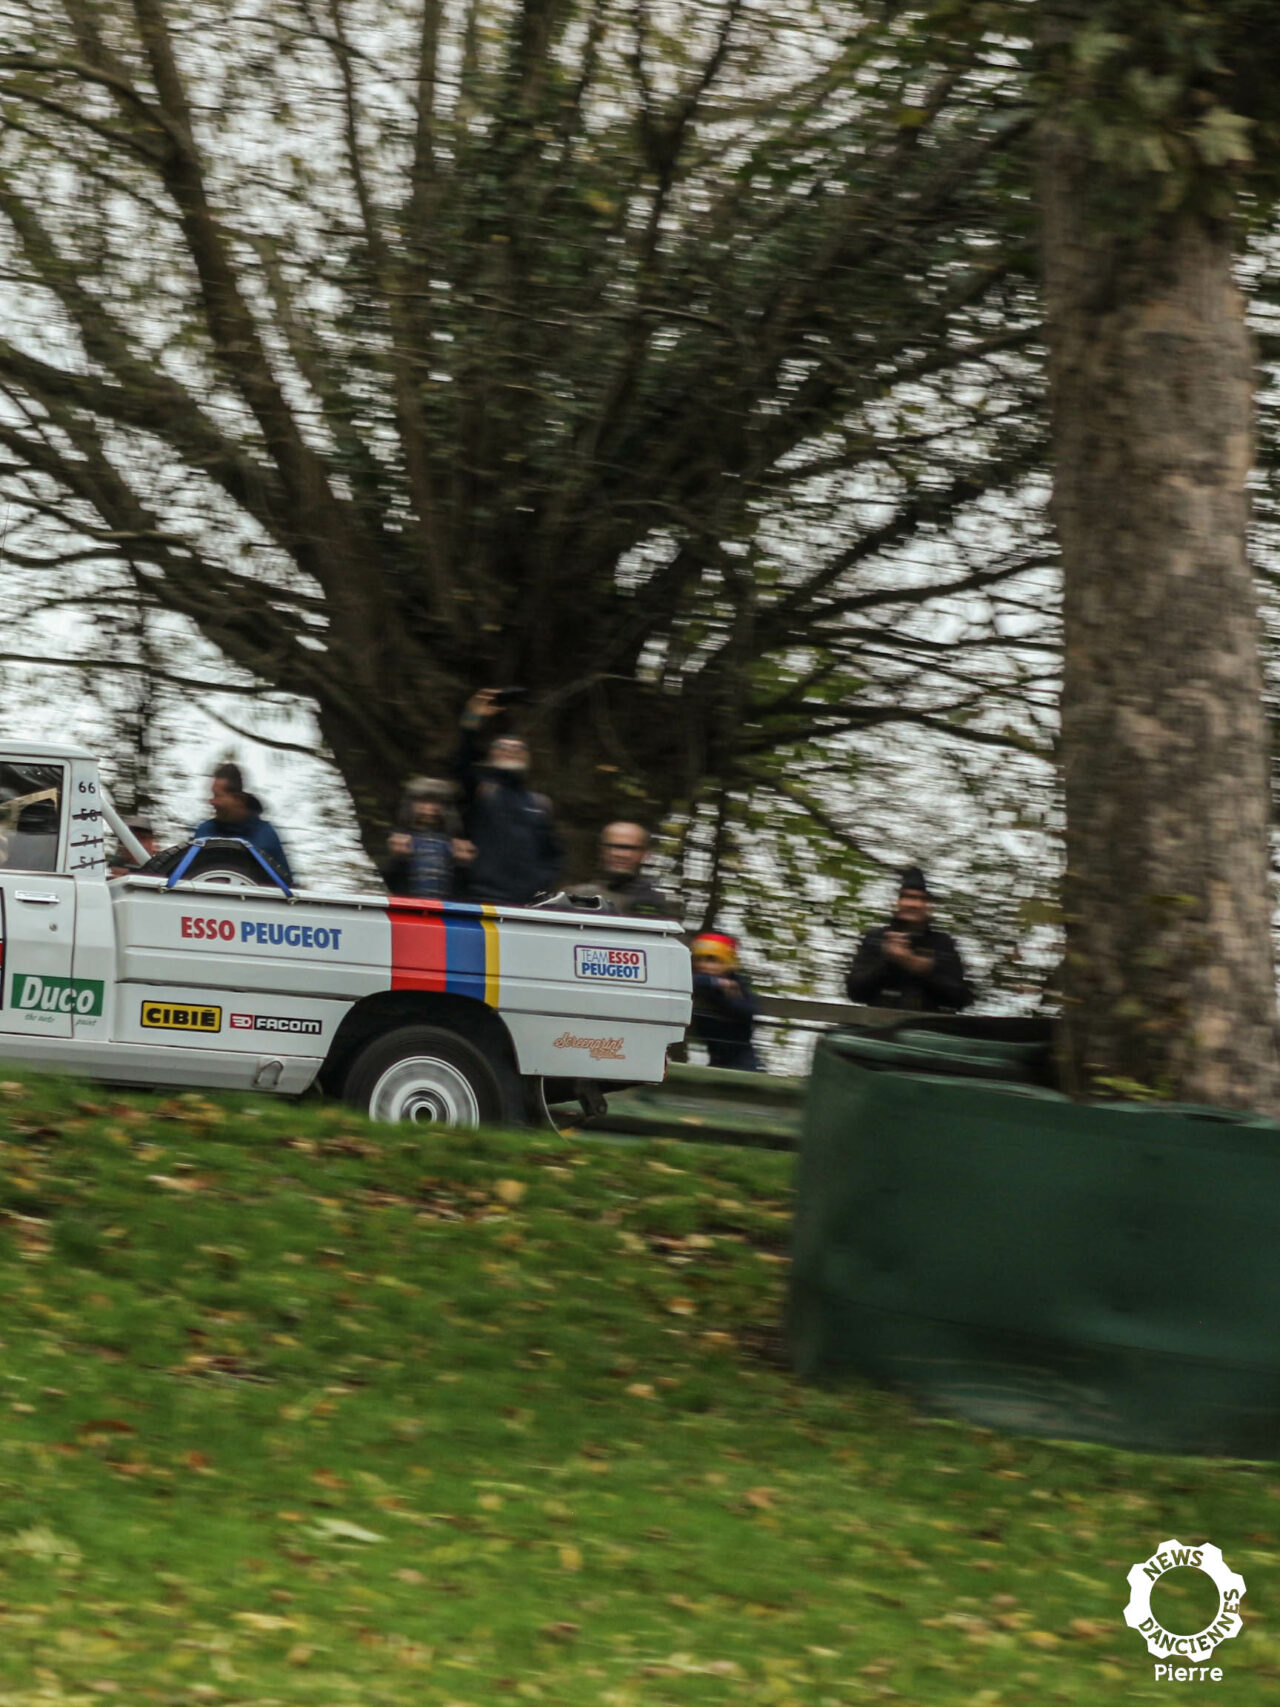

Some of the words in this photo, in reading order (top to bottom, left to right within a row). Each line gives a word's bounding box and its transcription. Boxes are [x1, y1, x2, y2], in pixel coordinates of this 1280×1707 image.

[78, 781, 96, 794] 66
[181, 916, 235, 941] ESSO
[240, 921, 342, 950] PEUGEOT
[581, 962, 640, 979] PEUGEOT
[19, 976, 95, 1014] Duco
[146, 1007, 216, 1027] CIBIÉ
[256, 1018, 320, 1033] FACOM
